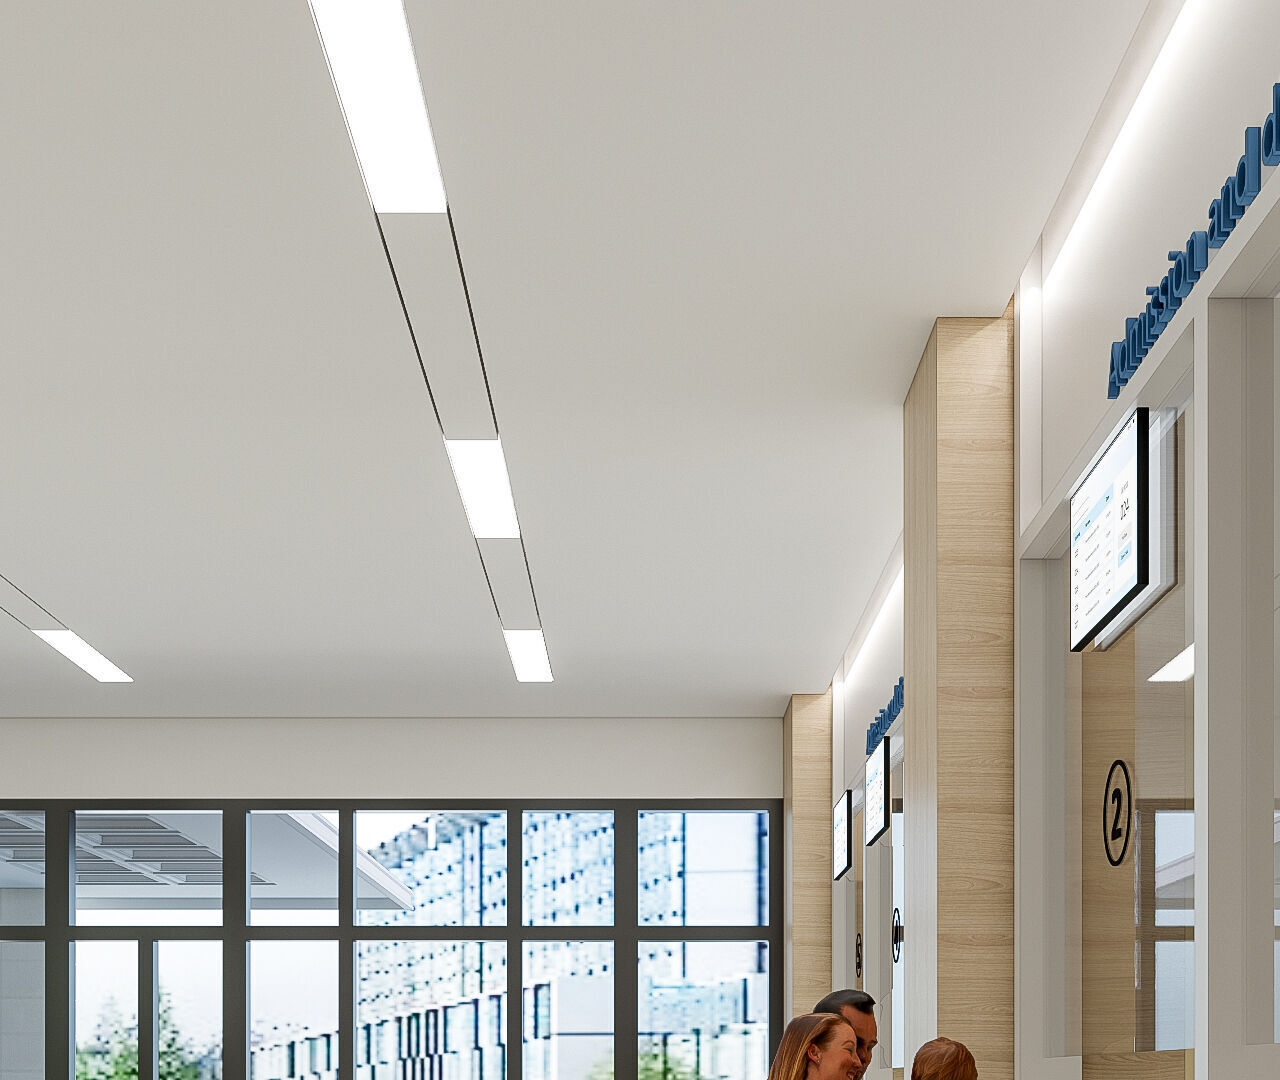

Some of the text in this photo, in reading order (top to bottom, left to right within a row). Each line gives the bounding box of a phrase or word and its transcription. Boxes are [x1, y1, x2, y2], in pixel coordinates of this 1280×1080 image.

[1107, 231, 1208, 399] Admission
[1208, 127, 1261, 248] and
[1111, 788, 1122, 842] 2
